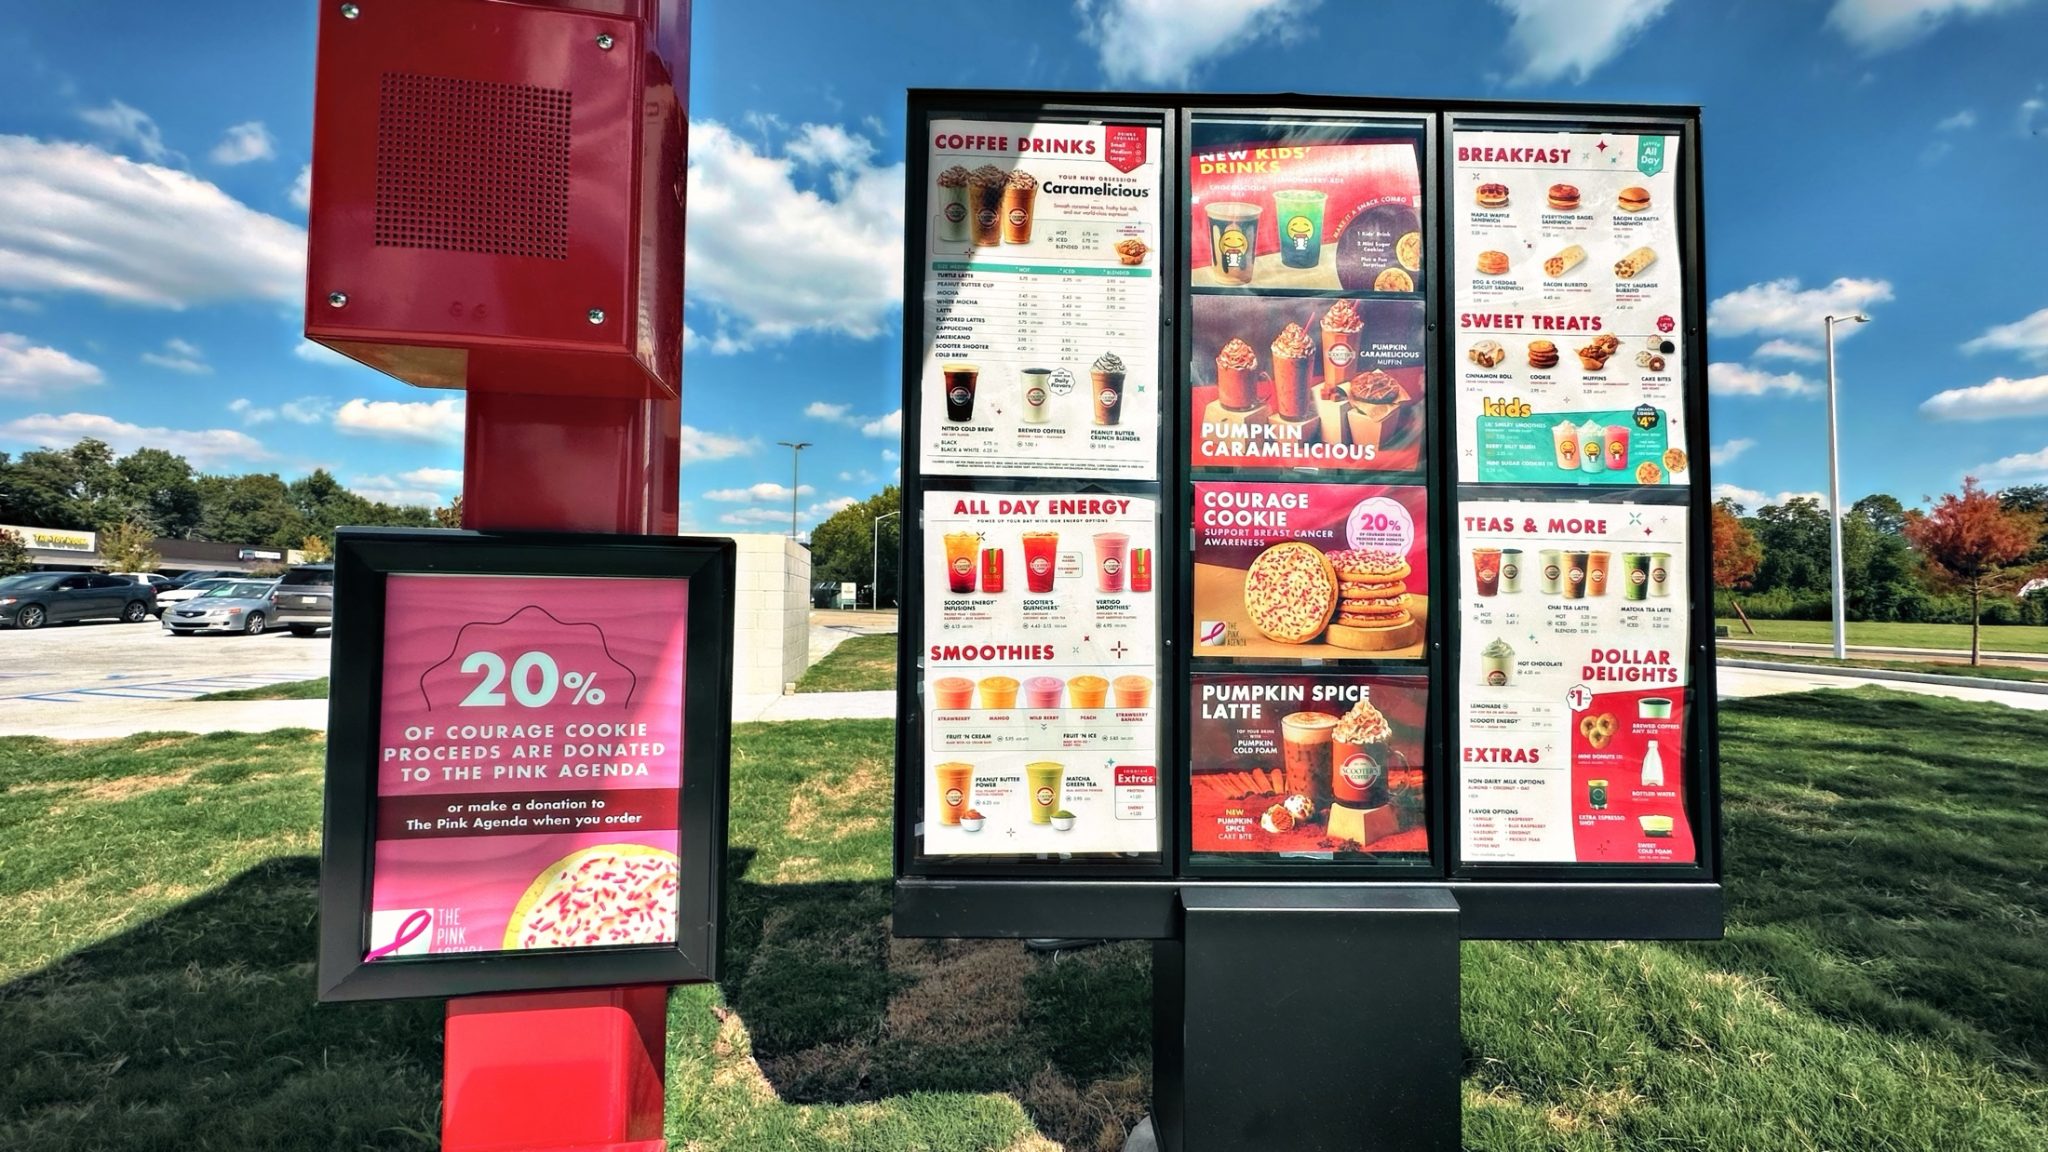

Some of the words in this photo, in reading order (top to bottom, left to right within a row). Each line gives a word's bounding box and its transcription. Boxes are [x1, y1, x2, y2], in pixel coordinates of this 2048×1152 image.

[934, 134, 1008, 152] COFFEE
[1017, 138, 1096, 155] DRINKS
[1644, 147, 1658, 156] All
[1200, 150, 1248, 162] NEW
[1256, 147, 1311, 160] KIDS'
[1458, 147, 1571, 164] BREAKFAST
[1640, 155, 1660, 166] Day
[1200, 160, 1281, 174] DRINKS
[1043, 181, 1149, 198] Caramelicious
[1332, 219, 1347, 239] MAKE
[1344, 213, 1351, 222] IT
[1356, 198, 1380, 211] SNACK
[1380, 195, 1407, 203] COMBO
[1461, 313, 1525, 329] SWEET
[1532, 315, 1602, 331] TREATS
[1360, 350, 1420, 358] CARAMELICIOUS
[1372, 343, 1407, 351] PUMPKIN
[1377, 358, 1403, 366] MUFFIN
[1483, 397, 1532, 418] kids
[1201, 423, 1302, 440] PUMPKIN
[1201, 442, 1376, 461] CARAMELICIOUS
[953, 500, 990, 515] ALL
[997, 500, 1040, 515] DAY
[1048, 499, 1131, 515] ENERGY
[1203, 492, 1309, 509] COURAGE
[1203, 510, 1287, 527] COOKIE
[1361, 513, 1401, 531] 20%
[1464, 517, 1515, 532] TEAS
[1523, 518, 1539, 533] &
[1547, 518, 1607, 534] MORE
[1204, 527, 1250, 537] SUPPORT
[1253, 529, 1291, 537] BREAST
[1293, 529, 1334, 538] CANCER
[1204, 537, 1265, 547] AWARENESS
[1227, 622, 1238, 630] THE
[1225, 638, 1247, 647] AGENDA
[930, 644, 1055, 661] SMOOTHIES
[1590, 648, 1671, 666] DOLLAR
[458, 650, 606, 708] 20%
[1582, 665, 1678, 683] DELIGHTS
[1202, 685, 1304, 701] PUMPKIN
[1311, 685, 1371, 701] SPICE
[1570, 689, 1583, 707] $1
[1202, 703, 1262, 719] LATTE
[404, 726, 435, 741] OF
[446, 724, 555, 740] COURAGE
[565, 723, 648, 738] COOKIE
[1237, 739, 1274, 747] PUMPKIN
[383, 746, 501, 762] PROCEEDS
[511, 744, 553, 759] ARE
[563, 742, 666, 757] DONATED
[1463, 747, 1540, 764] EXTRAS
[401, 767, 431, 782] TO
[442, 766, 482, 780] THE
[493, 764, 548, 779] PINK
[558, 762, 649, 778] AGENDA
[1117, 774, 1154, 785] Extras
[447, 803, 464, 813] or
[467, 801, 507, 813] make
[511, 802, 521, 811] a
[525, 799, 587, 811] donation
[591, 798, 606, 810] to
[406, 819, 434, 831] The
[437, 817, 468, 829] Pink
[473, 817, 528, 830] Agenda
[532, 815, 571, 827] when
[574, 815, 600, 828] you
[604, 812, 643, 825] order
[1217, 817, 1253, 825] PUMPKIN
[438, 908, 461, 926] THE
[437, 927, 466, 945] PINK
